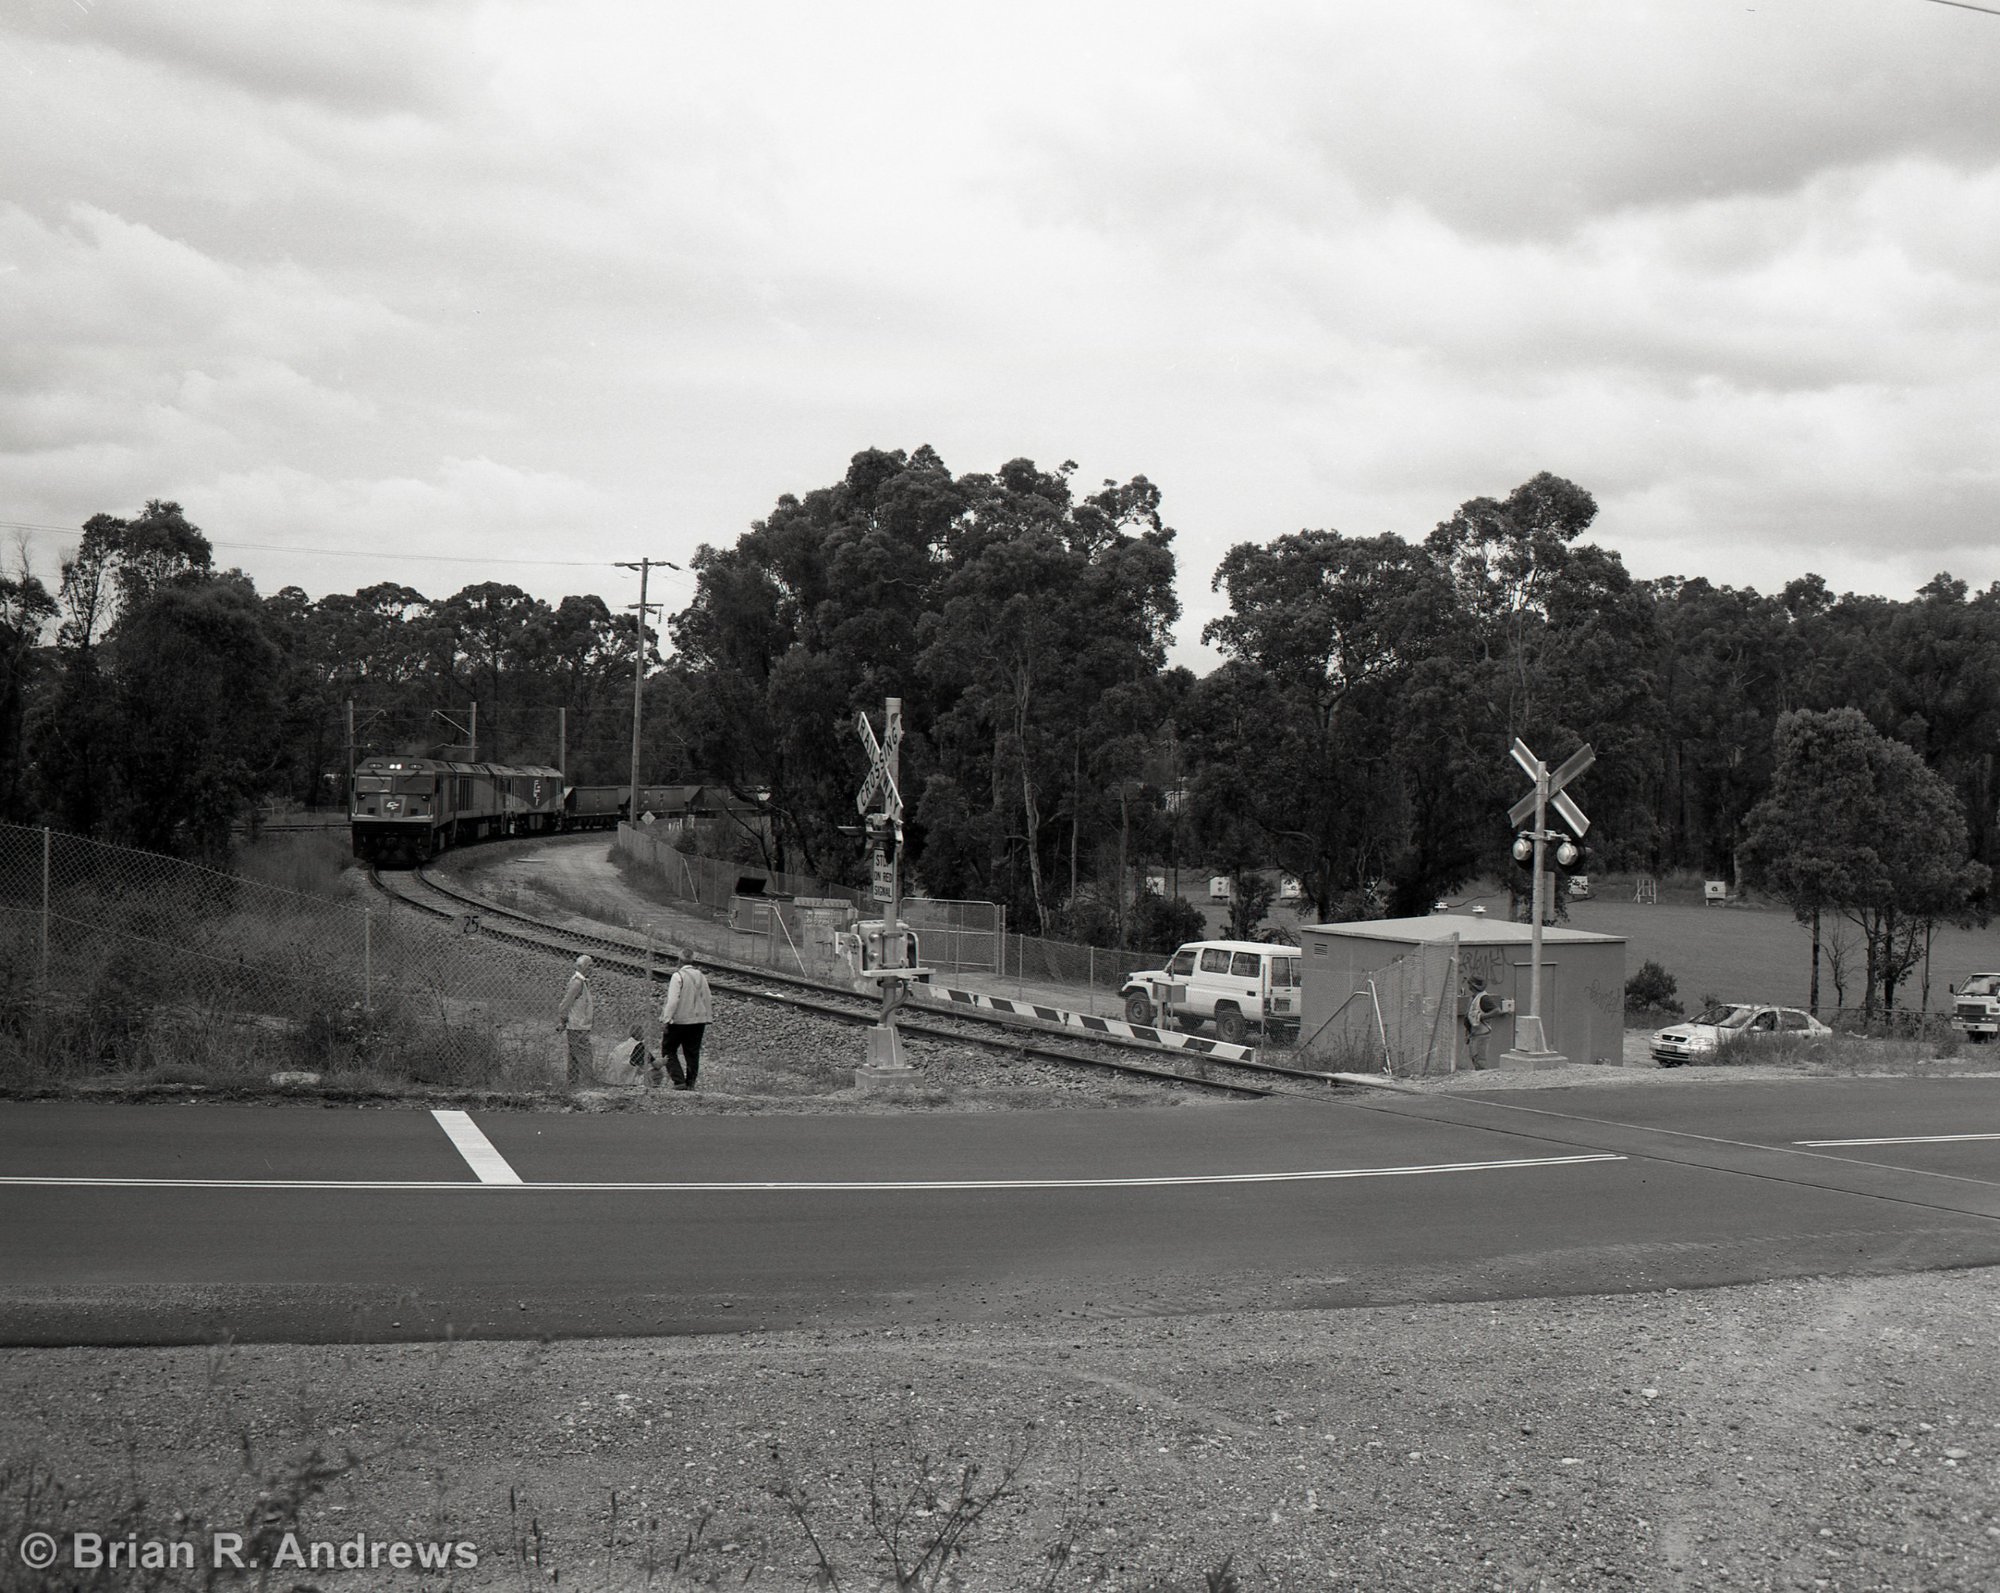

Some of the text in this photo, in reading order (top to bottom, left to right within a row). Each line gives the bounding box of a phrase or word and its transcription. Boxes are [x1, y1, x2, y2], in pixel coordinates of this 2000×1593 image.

[861, 726, 898, 807] CROSSING
[861, 719, 900, 815] RAILWAY
[463, 915, 479, 934] 25
